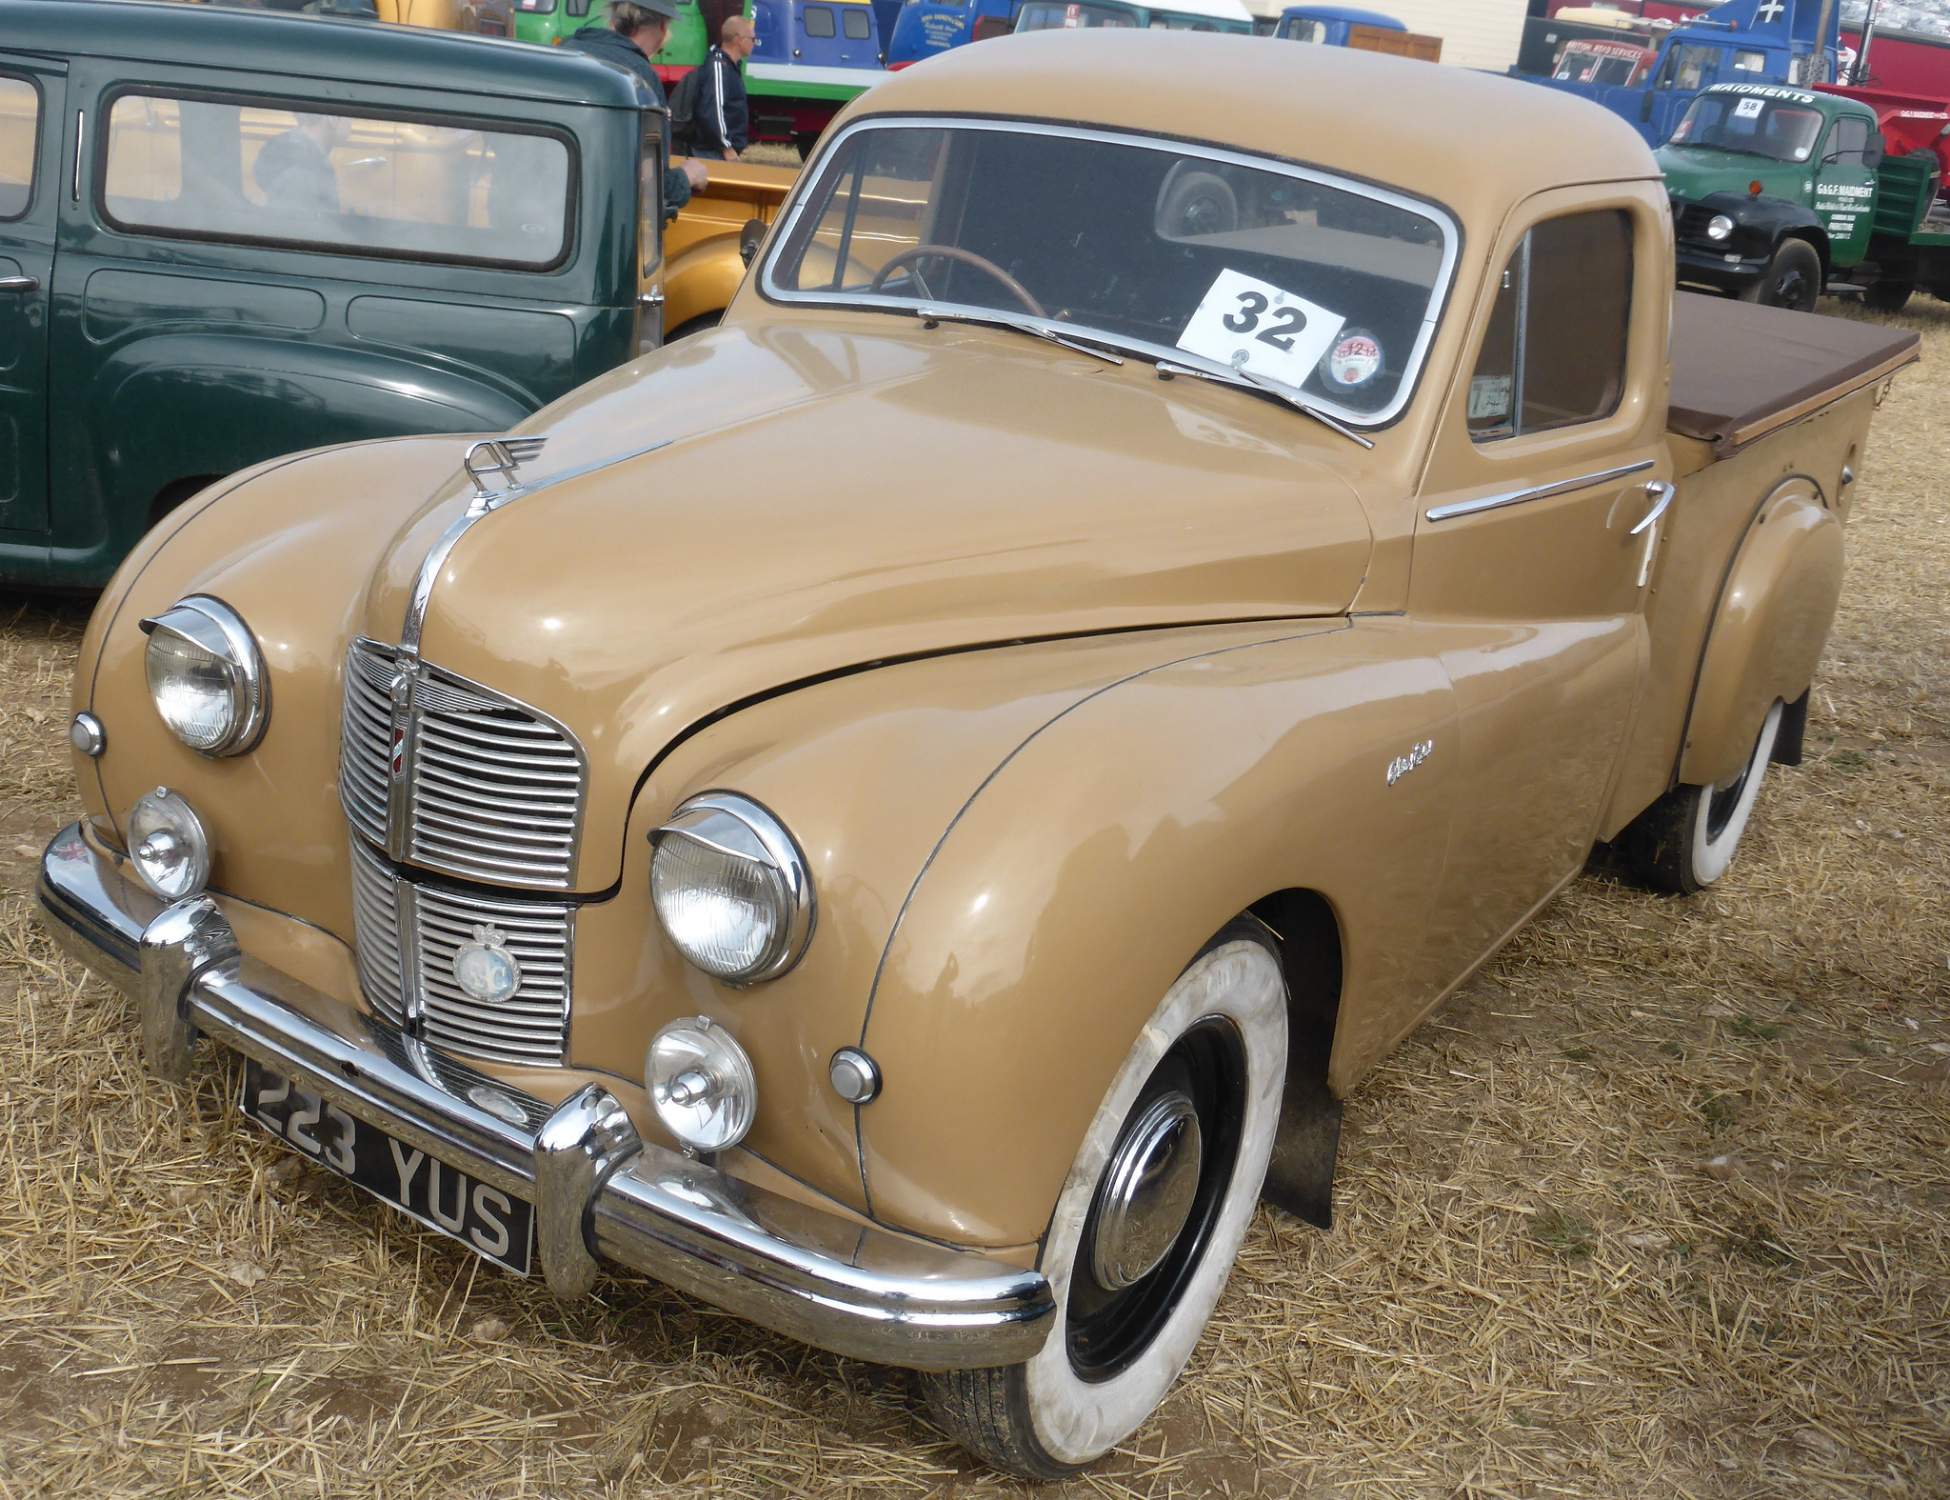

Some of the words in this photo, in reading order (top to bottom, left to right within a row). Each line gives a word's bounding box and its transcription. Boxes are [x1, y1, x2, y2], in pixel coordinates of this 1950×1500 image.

[1222, 290, 1308, 353] 32
[257, 1077, 357, 1175] 223
[387, 1136, 512, 1257] YUS
